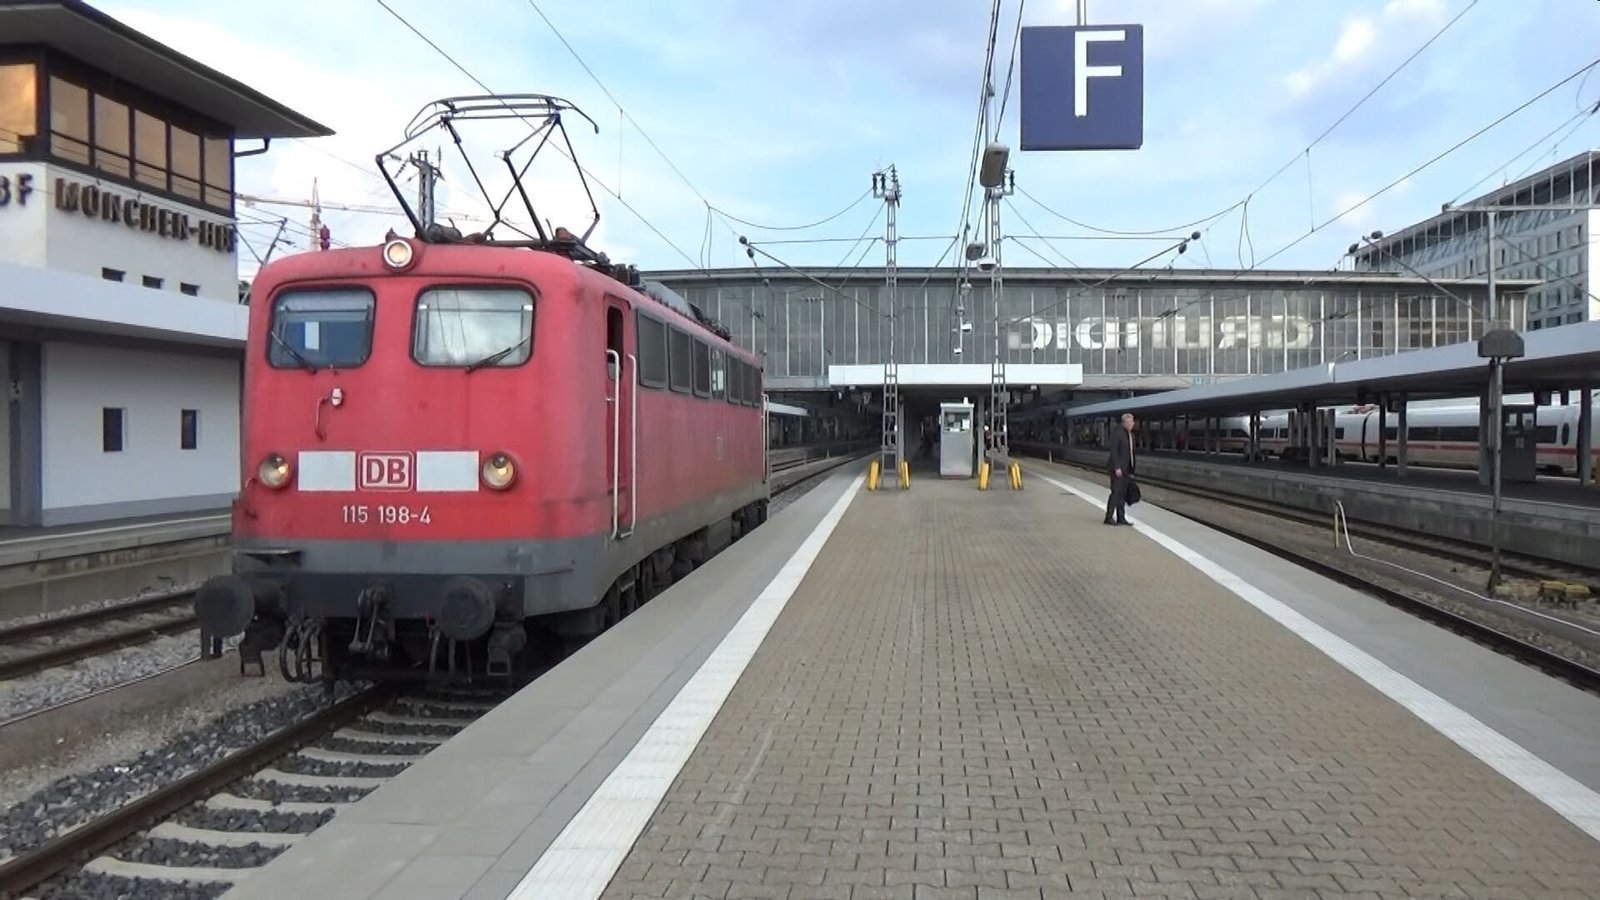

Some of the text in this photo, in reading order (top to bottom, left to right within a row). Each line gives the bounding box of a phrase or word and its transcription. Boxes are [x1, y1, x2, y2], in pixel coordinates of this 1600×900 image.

[1074, 29, 1126, 117] F
[366, 458, 406, 485] DB
[342, 505, 431, 524] 115 198-4
